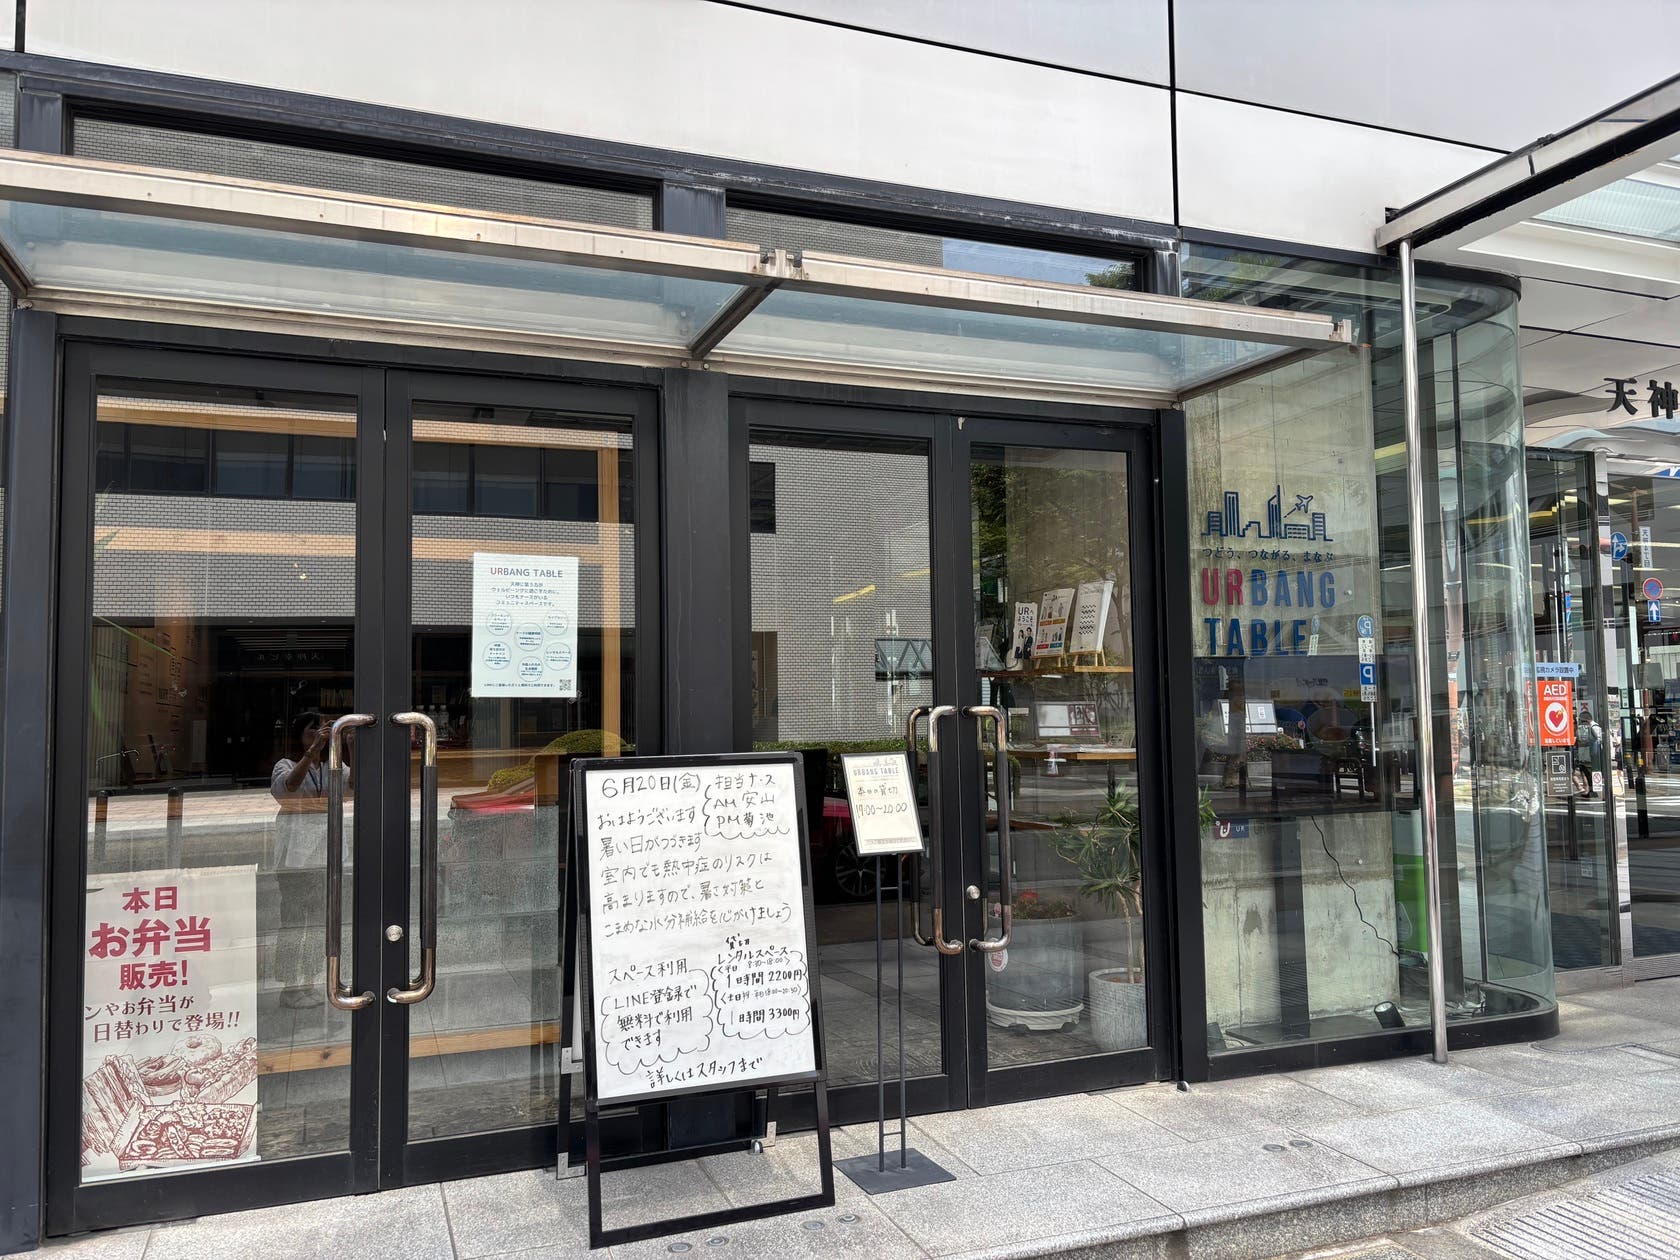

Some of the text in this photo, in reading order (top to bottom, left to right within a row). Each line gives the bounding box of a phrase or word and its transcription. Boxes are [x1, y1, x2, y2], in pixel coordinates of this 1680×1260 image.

[1603, 377, 1679, 420] 天神
[490, 567, 563, 578] URBANG TABLE
[1202, 567, 1336, 609] URBANG
[1203, 617, 1308, 657] TABLE
[1543, 684, 1567, 696] AED
[601, 772, 701, 798] 6月20日(金)
[598, 806, 697, 830] おはようございます
[713, 798, 737, 810] AM
[600, 832, 702, 861] 暑い日がつづきます
[600, 852, 773, 886] 室内でも熱中症のリスクは
[122, 885, 178, 914] 本日
[604, 902, 792, 938] こまめな水分補給を心がけましょう
[88, 915, 212, 960] お弁当
[717, 945, 788, 965] レンタルスペース
[119, 959, 189, 991] 販売!
[608, 958, 688, 986] スペース利用
[614, 984, 697, 1010] LINE登録で
[617, 1006, 693, 1032] 無料で利用
[621, 1028, 662, 1051] できます
[646, 1056, 763, 1089] 詳しくはスタッフまで
